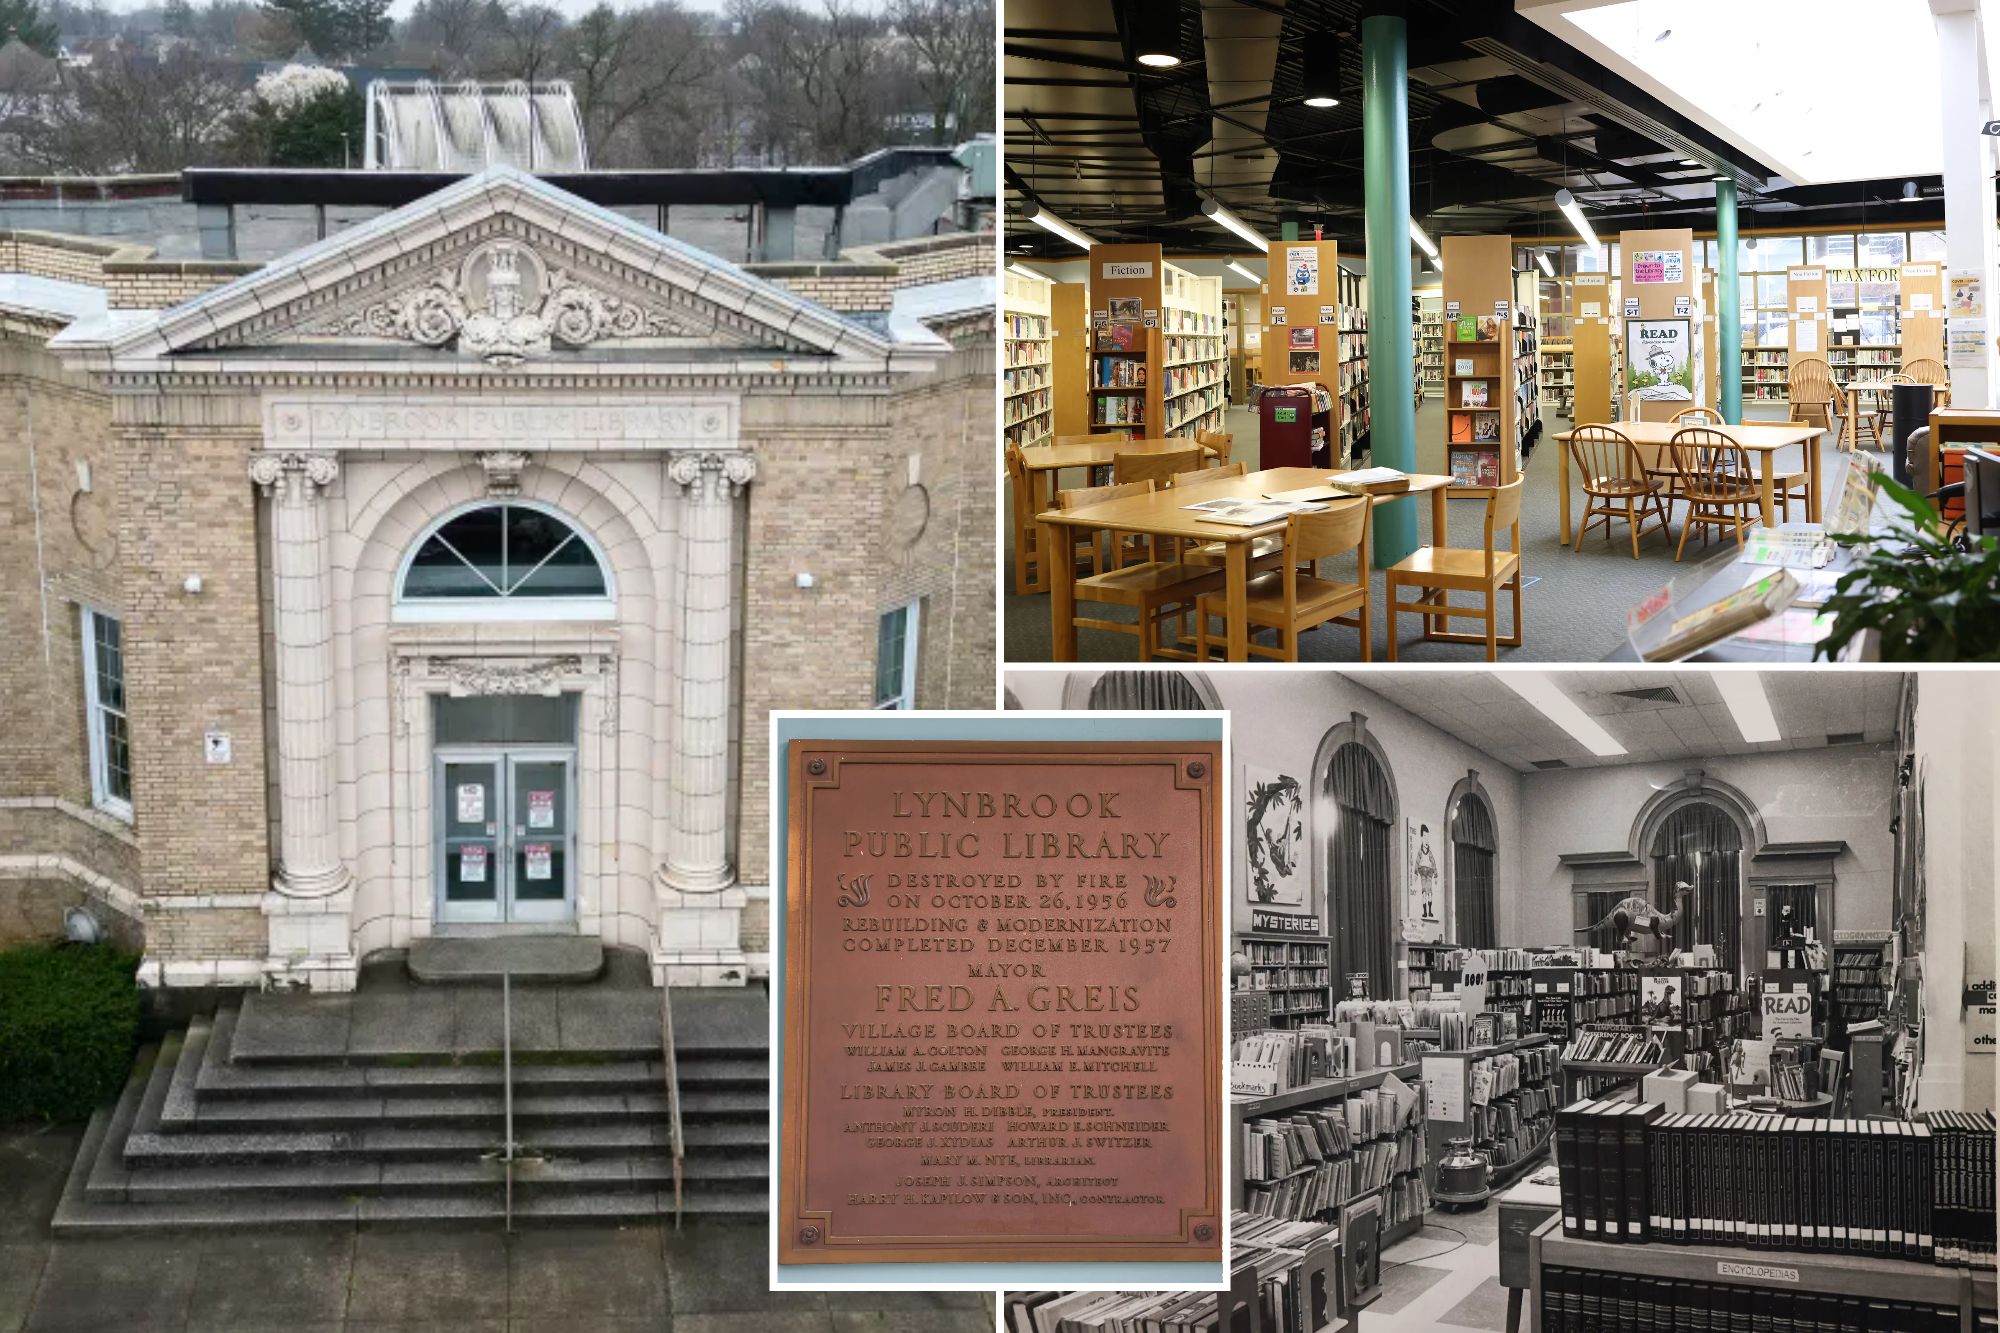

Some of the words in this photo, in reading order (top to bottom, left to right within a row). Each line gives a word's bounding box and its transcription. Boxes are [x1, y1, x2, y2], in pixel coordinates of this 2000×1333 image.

[1111, 265, 1145, 275] Fiction
[1833, 269, 1863, 282] TAX
[1869, 269, 1901, 282] FOR
[1274, 316, 1285, 324] J-L
[1640, 329, 1678, 338] READ
[313, 409, 458, 431] LYNBROOK
[474, 409, 570, 431] PUBLIC
[584, 409, 695, 431] LIBRARY
[893, 791, 1122, 819] LYNBROOK
[843, 831, 980, 858] PUBLIC
[1003, 831, 1170, 859] LIBRARY
[887, 873, 1022, 888] DESTROYED
[1035, 873, 1065, 888] BY
[1077, 873, 1128, 888] FIRE
[887, 894, 921, 909] ON
[932, 893, 1028, 909] OCTOBER
[842, 918, 969, 933] REBUILDING
[977, 918, 988, 932] &
[998, 918, 1172, 933] MODERNIZATION
[1253, 912, 1319, 931] MYSTERIES
[842, 938, 975, 953] COMPLETED
[988, 938, 1109, 953] DECEMBER
[1119, 938, 1171, 954] 1957
[968, 963, 1046, 978] MAYOR
[1464, 973, 1484, 987] BOO!
[1972, 980, 1996, 991] addi
[875, 984, 975, 1013] FRED
[989, 984, 1020, 1013] A.
[1028, 984, 1141, 1012] GREIS
[1763, 996, 1811, 1015] READ
[842, 1023, 937, 1039] VILLAGE
[947, 1023, 1020, 1039] BOARD
[1032, 1023, 1061, 1039] OF
[1070, 1023, 1173, 1039] TRUSTEES
[1620, 1032, 1644, 1040] BOOKS
[846, 1046, 907, 1057] WILLIAM
[1001, 1045, 1057, 1057] GEORGE
[1076, 1045, 1170, 1057] MANGRAVITE
[867, 1061, 912, 1073] JAMES
[1001, 1061, 1064, 1072] WILLIAM
[1083, 1061, 1158, 1072] MITCHELL
[841, 1083, 935, 1100] LIBRARY
[944, 1083, 1020, 1100] BOARD
[1033, 1083, 1061, 1099] OF
[1070, 1083, 1174, 1100] TRUSTEES
[903, 1106, 957, 1118] MYRON
[981, 1106, 1037, 1119] DIBBLE,
[1042, 1108, 1115, 1117] PRESIDENT.
[844, 1122, 917, 1133] ANTHONY
[1007, 1121, 1069, 1132] HOWARD
[1085, 1121, 1170, 1132] SCHNEIDER
[865, 1137, 923, 1148] GEORGE
[1008, 1137, 1067, 1148] ARTHUR
[1086, 1137, 1153, 1148] SWITZER
[920, 1155, 963, 1166] MARY
[896, 1175, 951, 1187] JOSEPH
[970, 1175, 1041, 1188] SIMPSON,
[1046, 1177, 1119, 1187] ARCHITECT
[848, 1194, 898, 1206] HARRY
[921, 1194, 987, 1205] KAPILOW
[1080, 1195, 1166, 1205] CONTRACTOR
[1722, 1264, 1796, 1280] ENCYCLOPEDIAS
